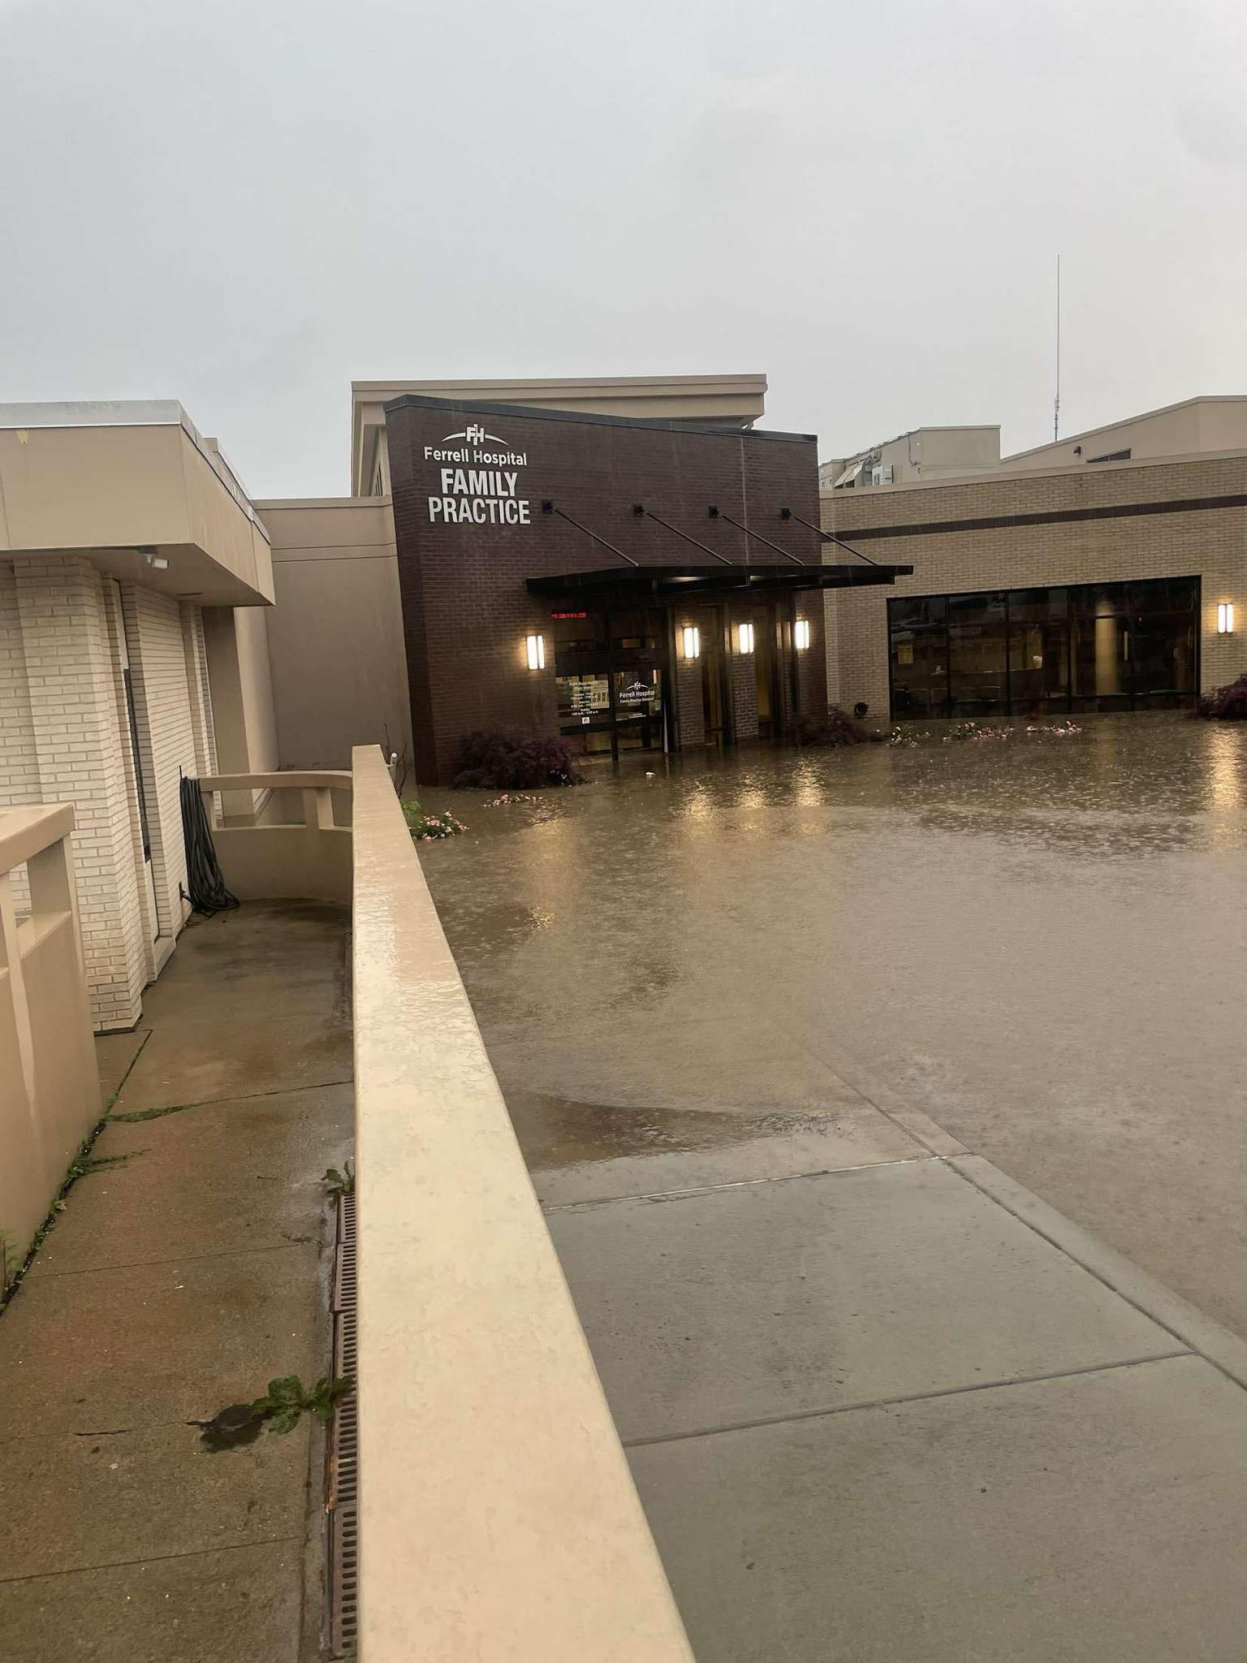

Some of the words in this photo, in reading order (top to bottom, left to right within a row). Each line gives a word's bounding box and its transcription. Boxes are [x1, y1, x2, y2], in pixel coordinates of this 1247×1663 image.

[424, 446, 469, 462] Ferrell
[473, 450, 527, 467] Hospital
[441, 468, 518, 497] FAMILY
[428, 497, 531, 525] PRACTICE
